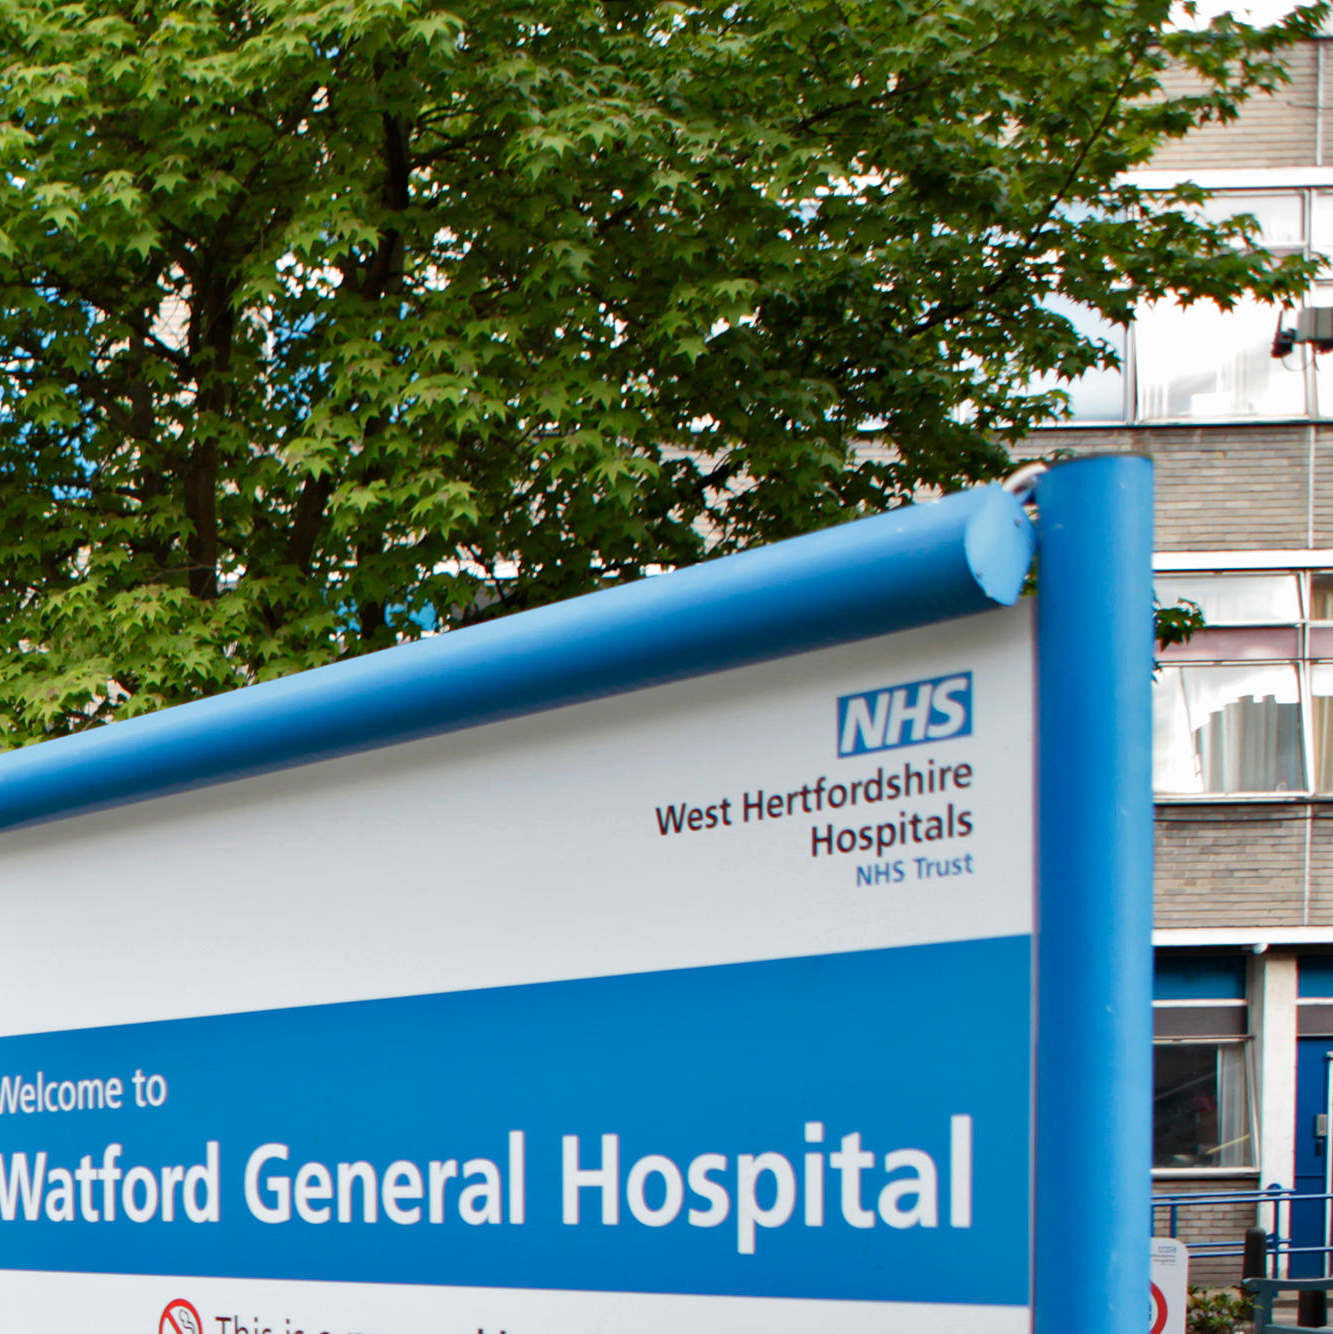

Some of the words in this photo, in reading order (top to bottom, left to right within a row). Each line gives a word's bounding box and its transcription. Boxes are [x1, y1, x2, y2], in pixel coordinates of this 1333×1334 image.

[840, 675, 970, 754] NHS
[655, 798, 732, 836] West
[742, 759, 973, 823] Hertfordshire
[811, 803, 973, 858] Hospitals
[856, 859, 906, 887] NHS
[914, 854, 974, 881] Trust
[132, 1069, 167, 1108] to
[244, 1130, 525, 1225] General
[562, 1114, 973, 1255] Hospital
